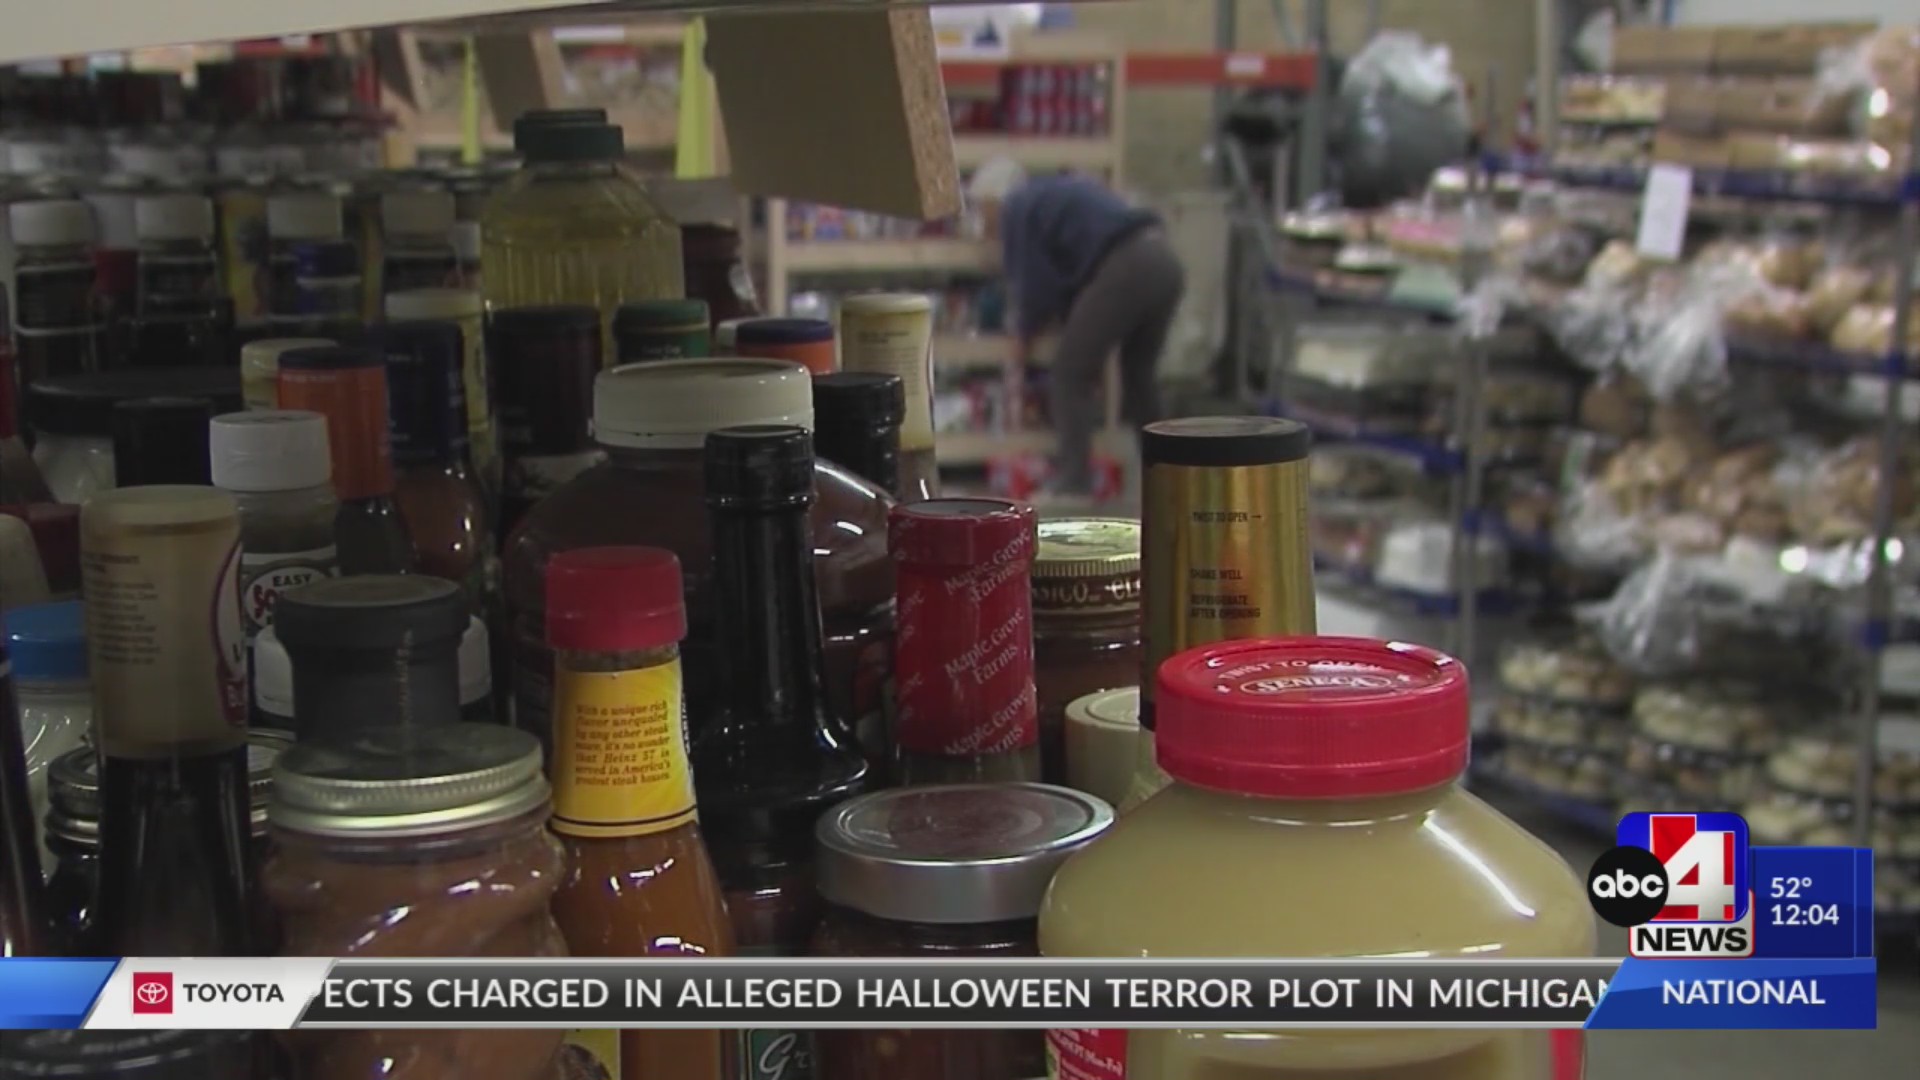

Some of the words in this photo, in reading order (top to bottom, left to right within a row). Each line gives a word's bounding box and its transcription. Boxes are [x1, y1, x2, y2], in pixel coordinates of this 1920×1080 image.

[1227, 511, 1249, 523] OPEN
[944, 562, 990, 596] Maple
[992, 528, 1030, 566] Grove
[272, 573, 312, 588] EASY
[1190, 568, 1217, 580] SHAKE
[1219, 568, 1243, 580] WELL
[1190, 607, 1217, 619] AFTER
[1219, 607, 1262, 619] OPENING
[944, 640, 992, 679] Maple
[991, 608, 1025, 645] Grove
[972, 644, 1018, 684] Farms
[1217, 661, 1273, 680] TWIST
[1278, 659, 1308, 668] TO
[1256, 674, 1379, 692] SENECA
[576, 703, 598, 715] With
[610, 704, 648, 716] unique
[649, 699, 668, 712] rich
[611, 711, 668, 727] unequaled
[944, 722, 994, 755] Maple
[992, 690, 1031, 728] Grove
[588, 730, 610, 742] any
[611, 727, 642, 740] other
[643, 723, 669, 736] steak
[621, 742, 637, 751] no
[637, 736, 671, 750] wonder
[575, 753, 598, 764] that
[603, 752, 638, 764] Heinz
[642, 748, 656, 762] 57
[660, 748, 671, 758] is
[575, 765, 607, 776] served
[608, 765, 620, 776] in
[621, 760, 671, 776] America's
[611, 774, 638, 786] steak
